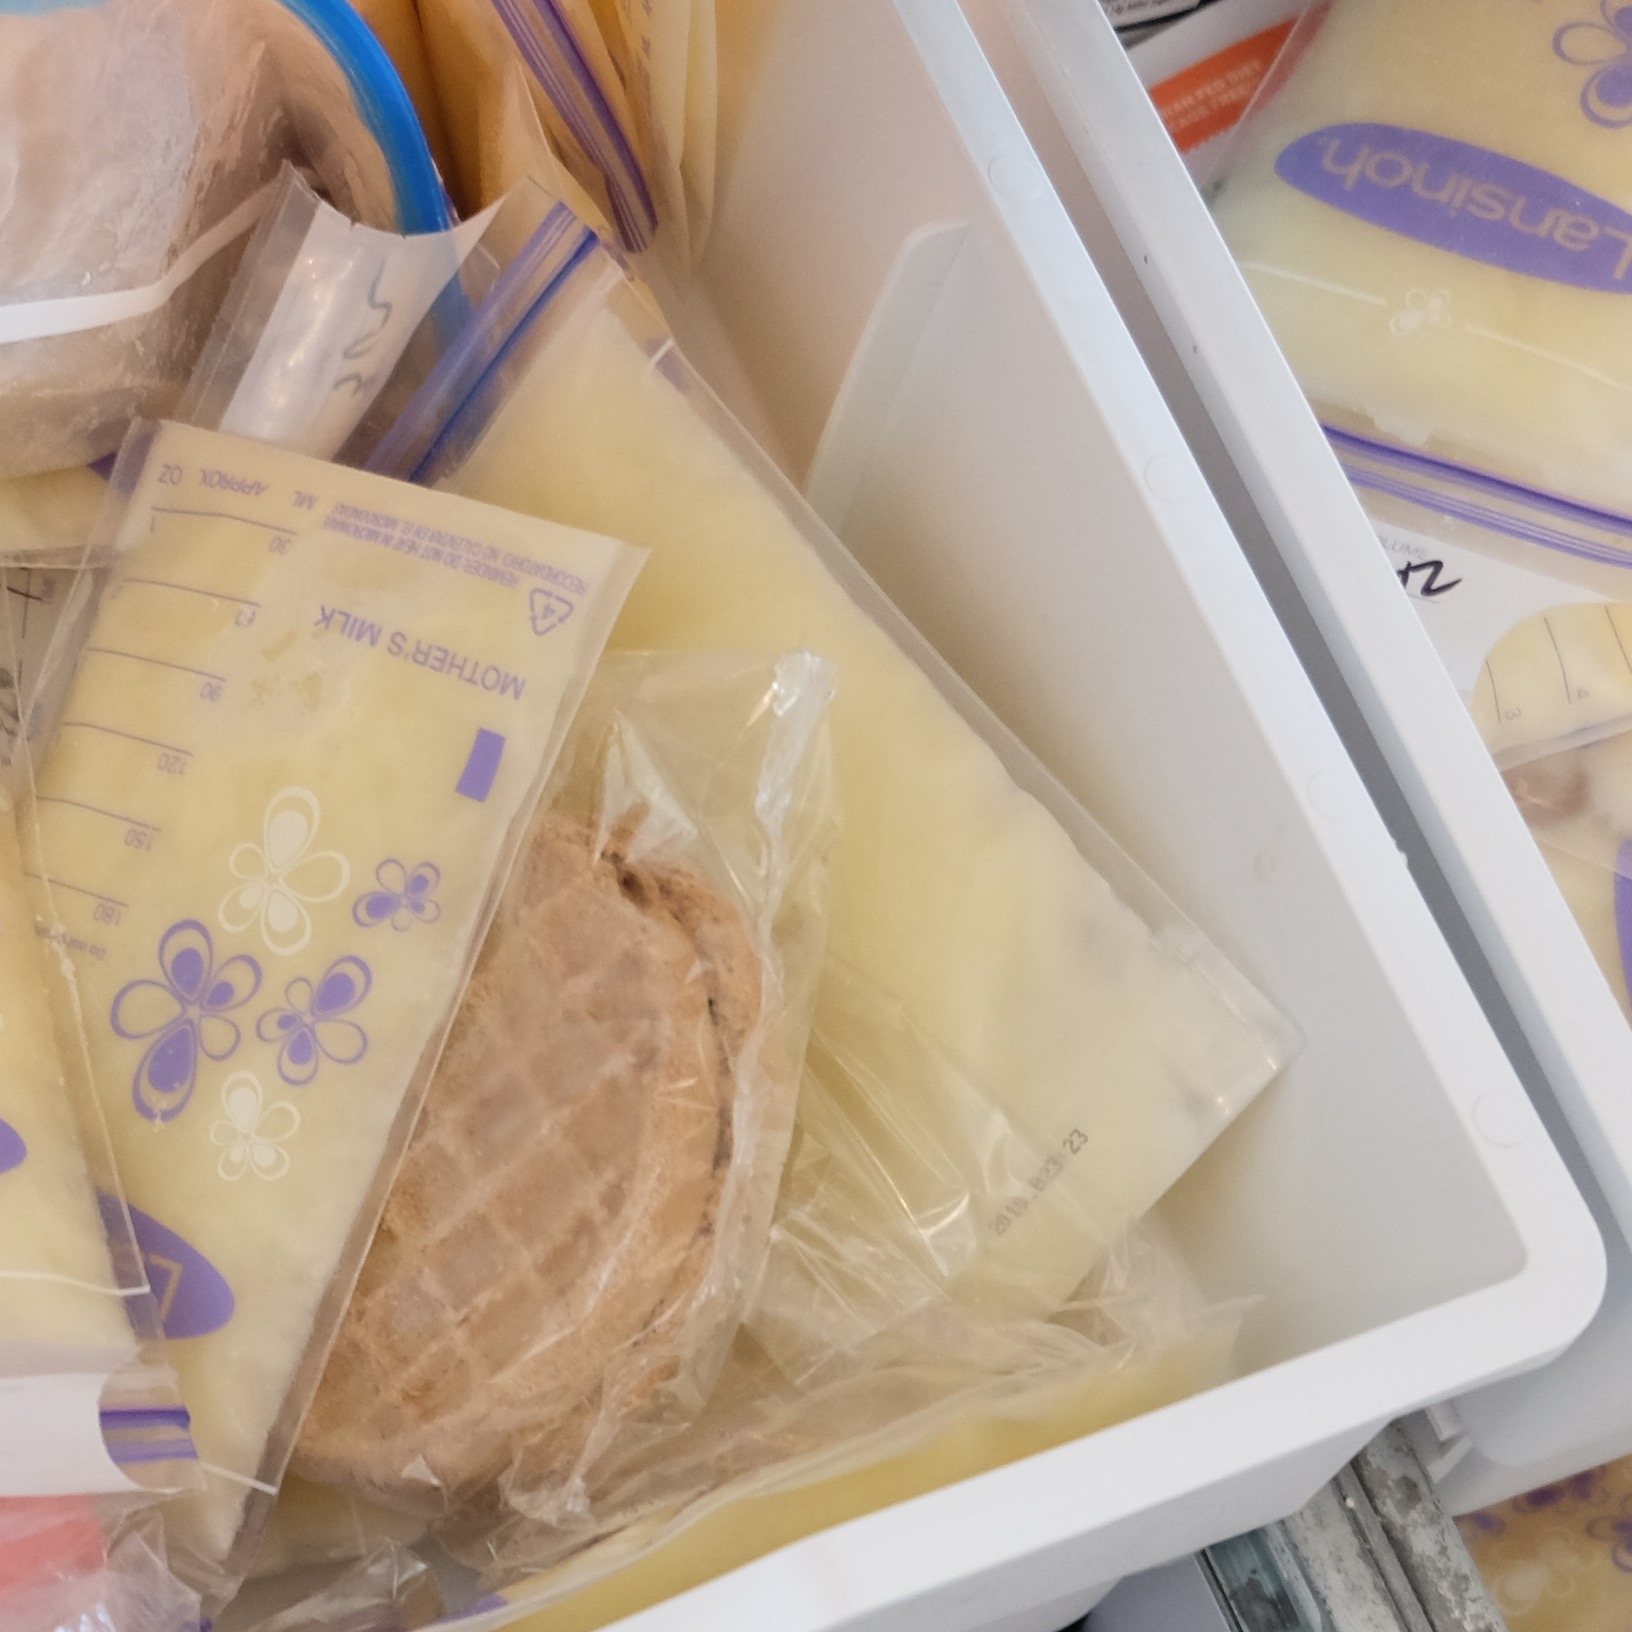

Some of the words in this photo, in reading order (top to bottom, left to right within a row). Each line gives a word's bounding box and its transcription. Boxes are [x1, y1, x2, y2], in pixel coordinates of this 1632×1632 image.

[158, 464, 183, 486] OZ
[314, 604, 384, 648] MILK
[386, 630, 527, 702] MOTHER'S
[200, 681, 224, 703] 90
[157, 753, 188, 776] 120
